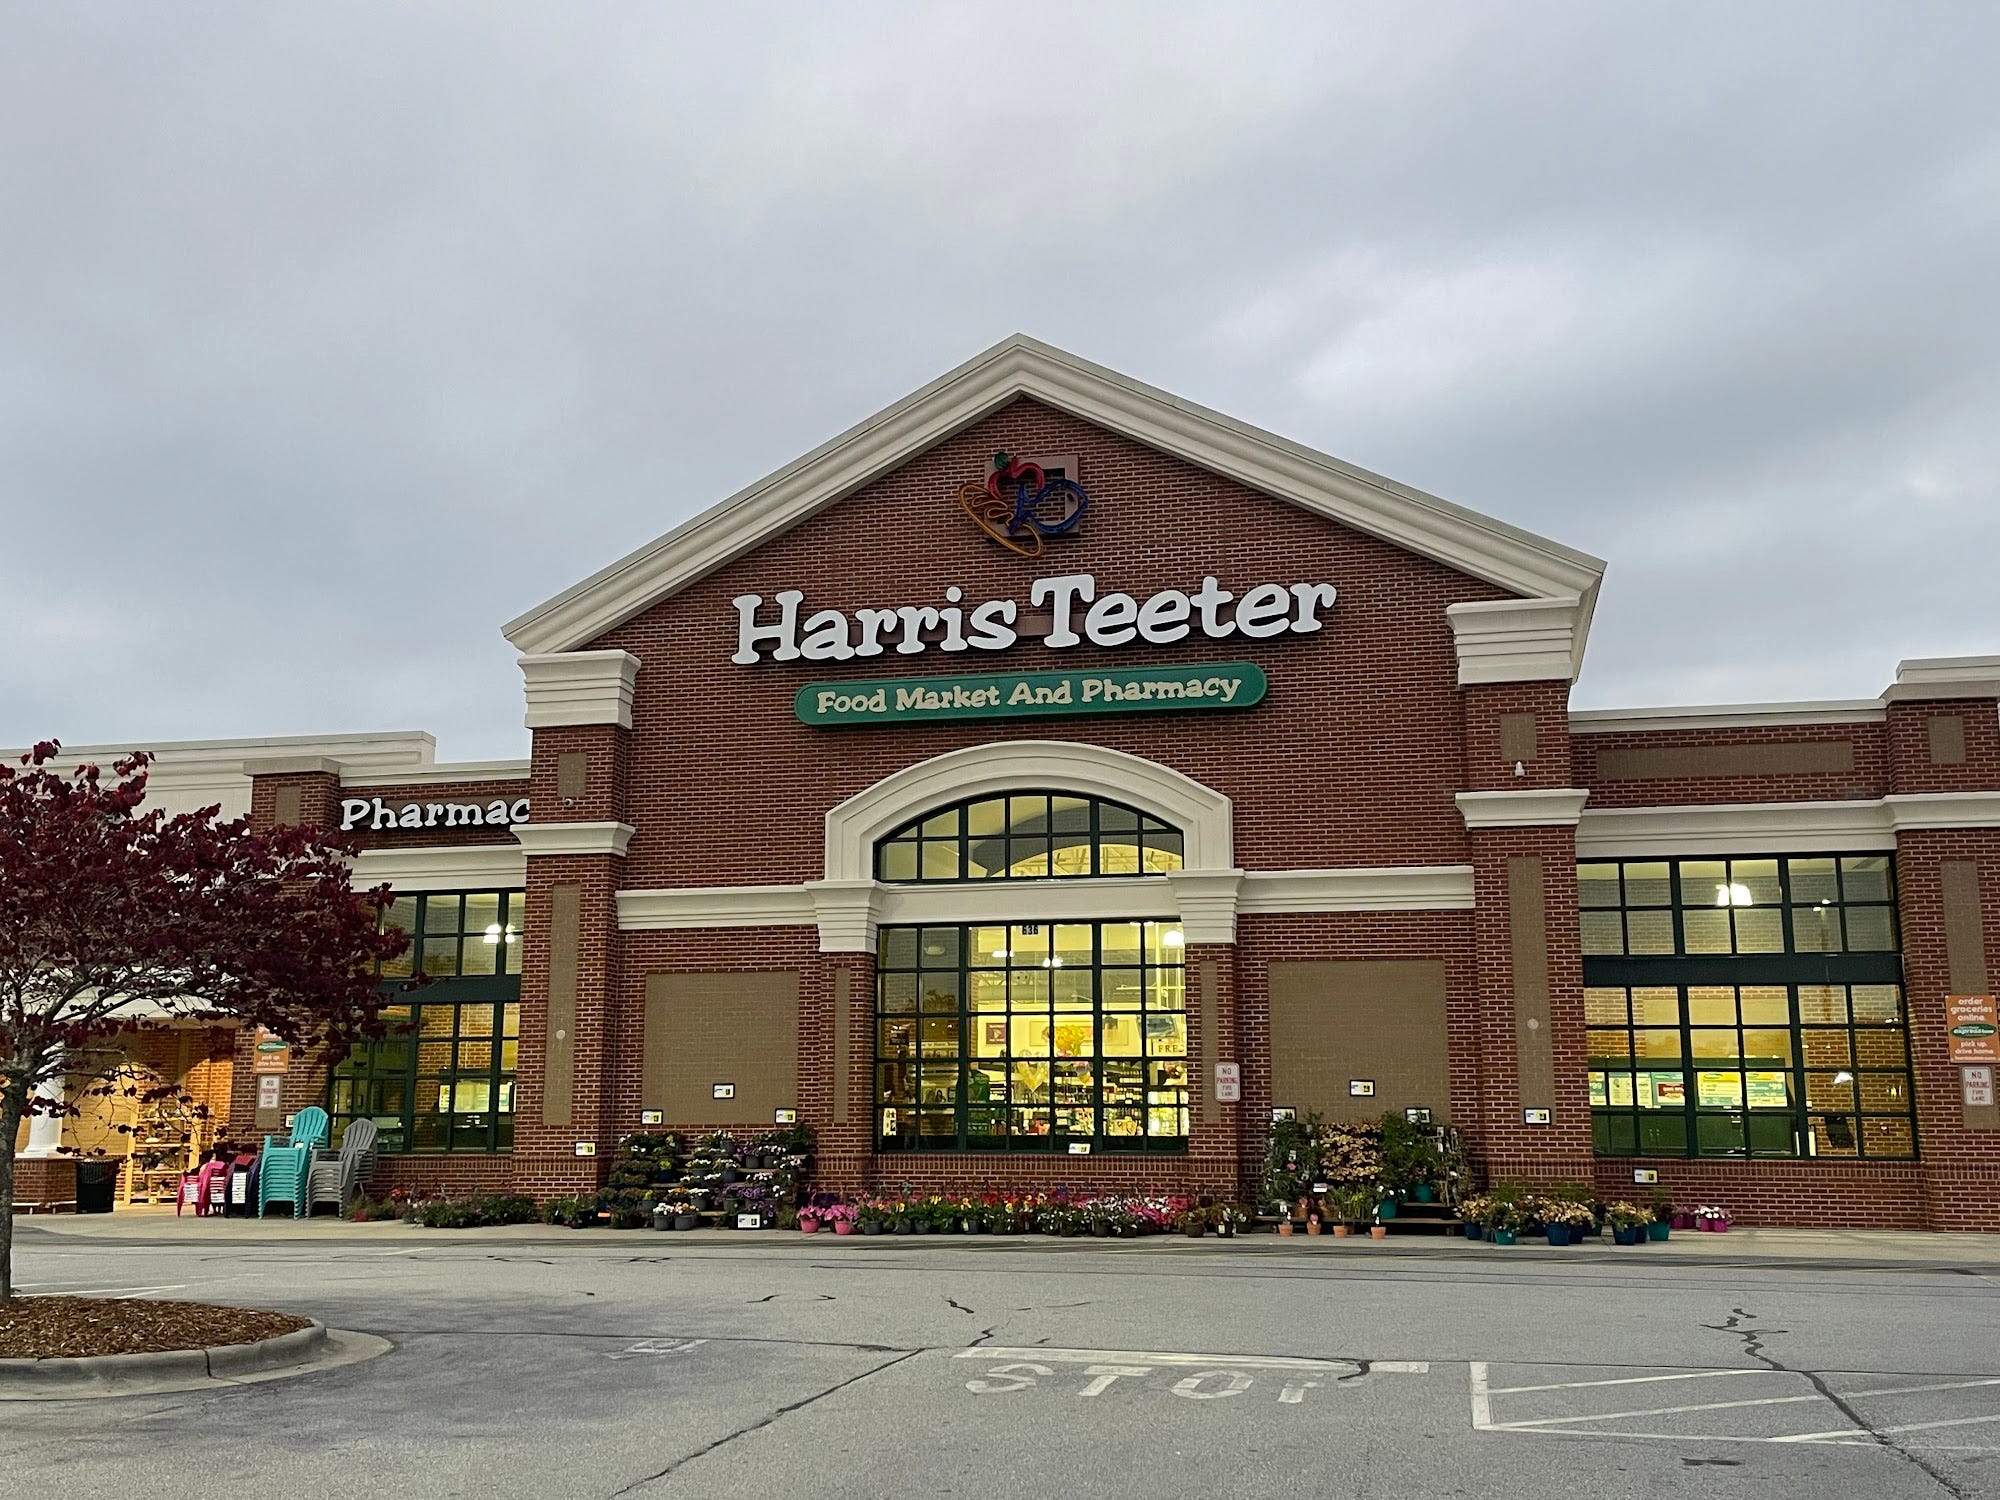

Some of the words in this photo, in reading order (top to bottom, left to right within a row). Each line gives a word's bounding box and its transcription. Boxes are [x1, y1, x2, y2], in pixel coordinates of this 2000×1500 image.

[730, 585, 1017, 664] Harris
[1030, 573, 1337, 648] Teeter
[816, 688, 887, 714] Food
[895, 685, 1000, 711] Market
[1007, 679, 1073, 706] And
[1081, 677, 1242, 703] Pharmacy
[1958, 997, 1984, 1006] order
[1950, 1006, 1993, 1014] groceries
[1222, 1067, 1232, 1075] NO
[1971, 1071, 1982, 1079] NO
[1966, 1081, 1990, 1089] PARKING
